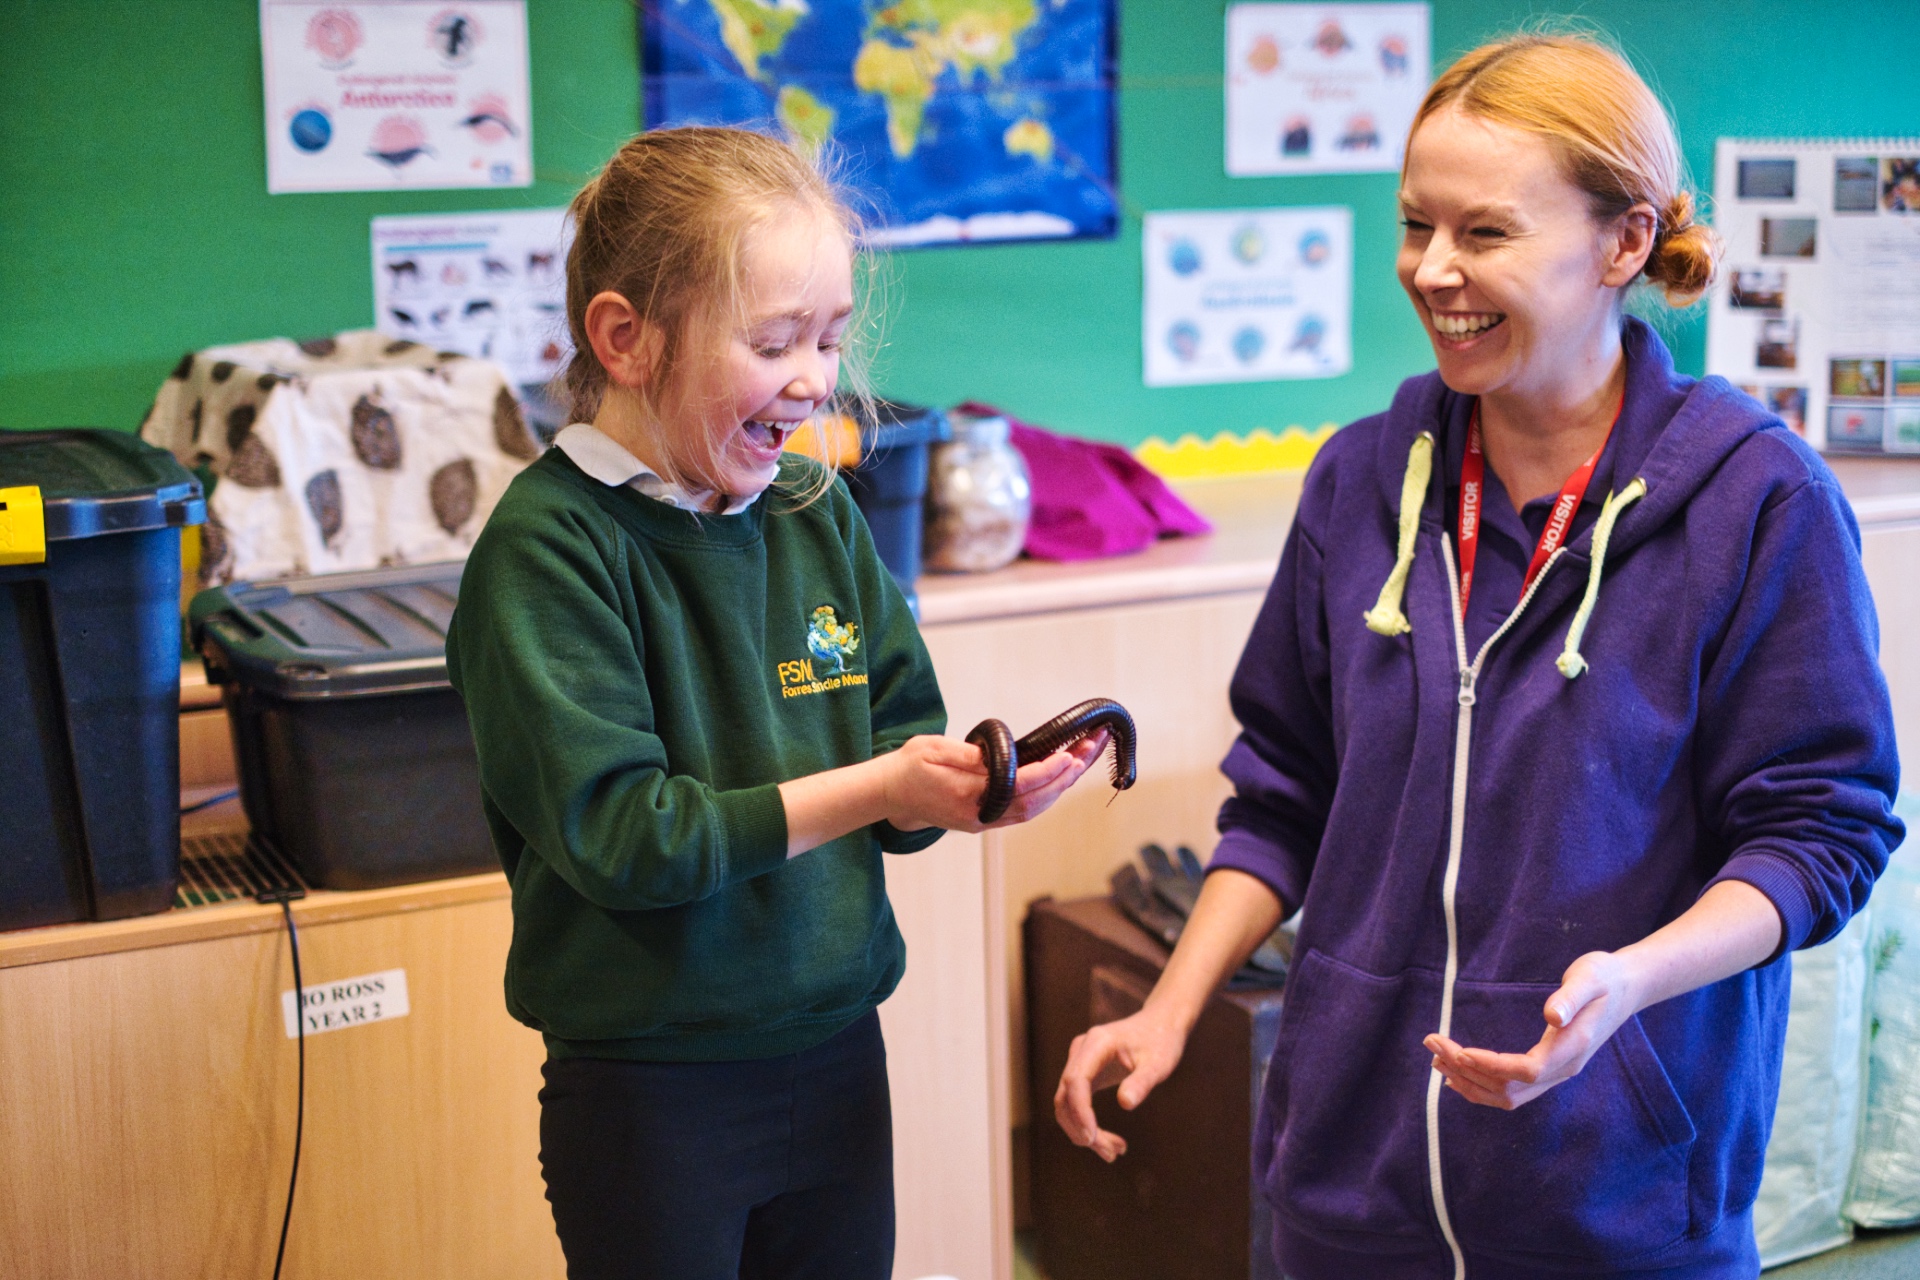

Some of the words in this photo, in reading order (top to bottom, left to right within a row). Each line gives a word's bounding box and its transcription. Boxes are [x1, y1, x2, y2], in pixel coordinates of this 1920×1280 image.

[1462, 481, 1479, 541] VISITOR
[1541, 493, 1577, 553] VISITOR
[331, 977, 386, 1001] ROSS
[308, 1005, 366, 1030] YEAR
[373, 1001, 383, 1018] 2
